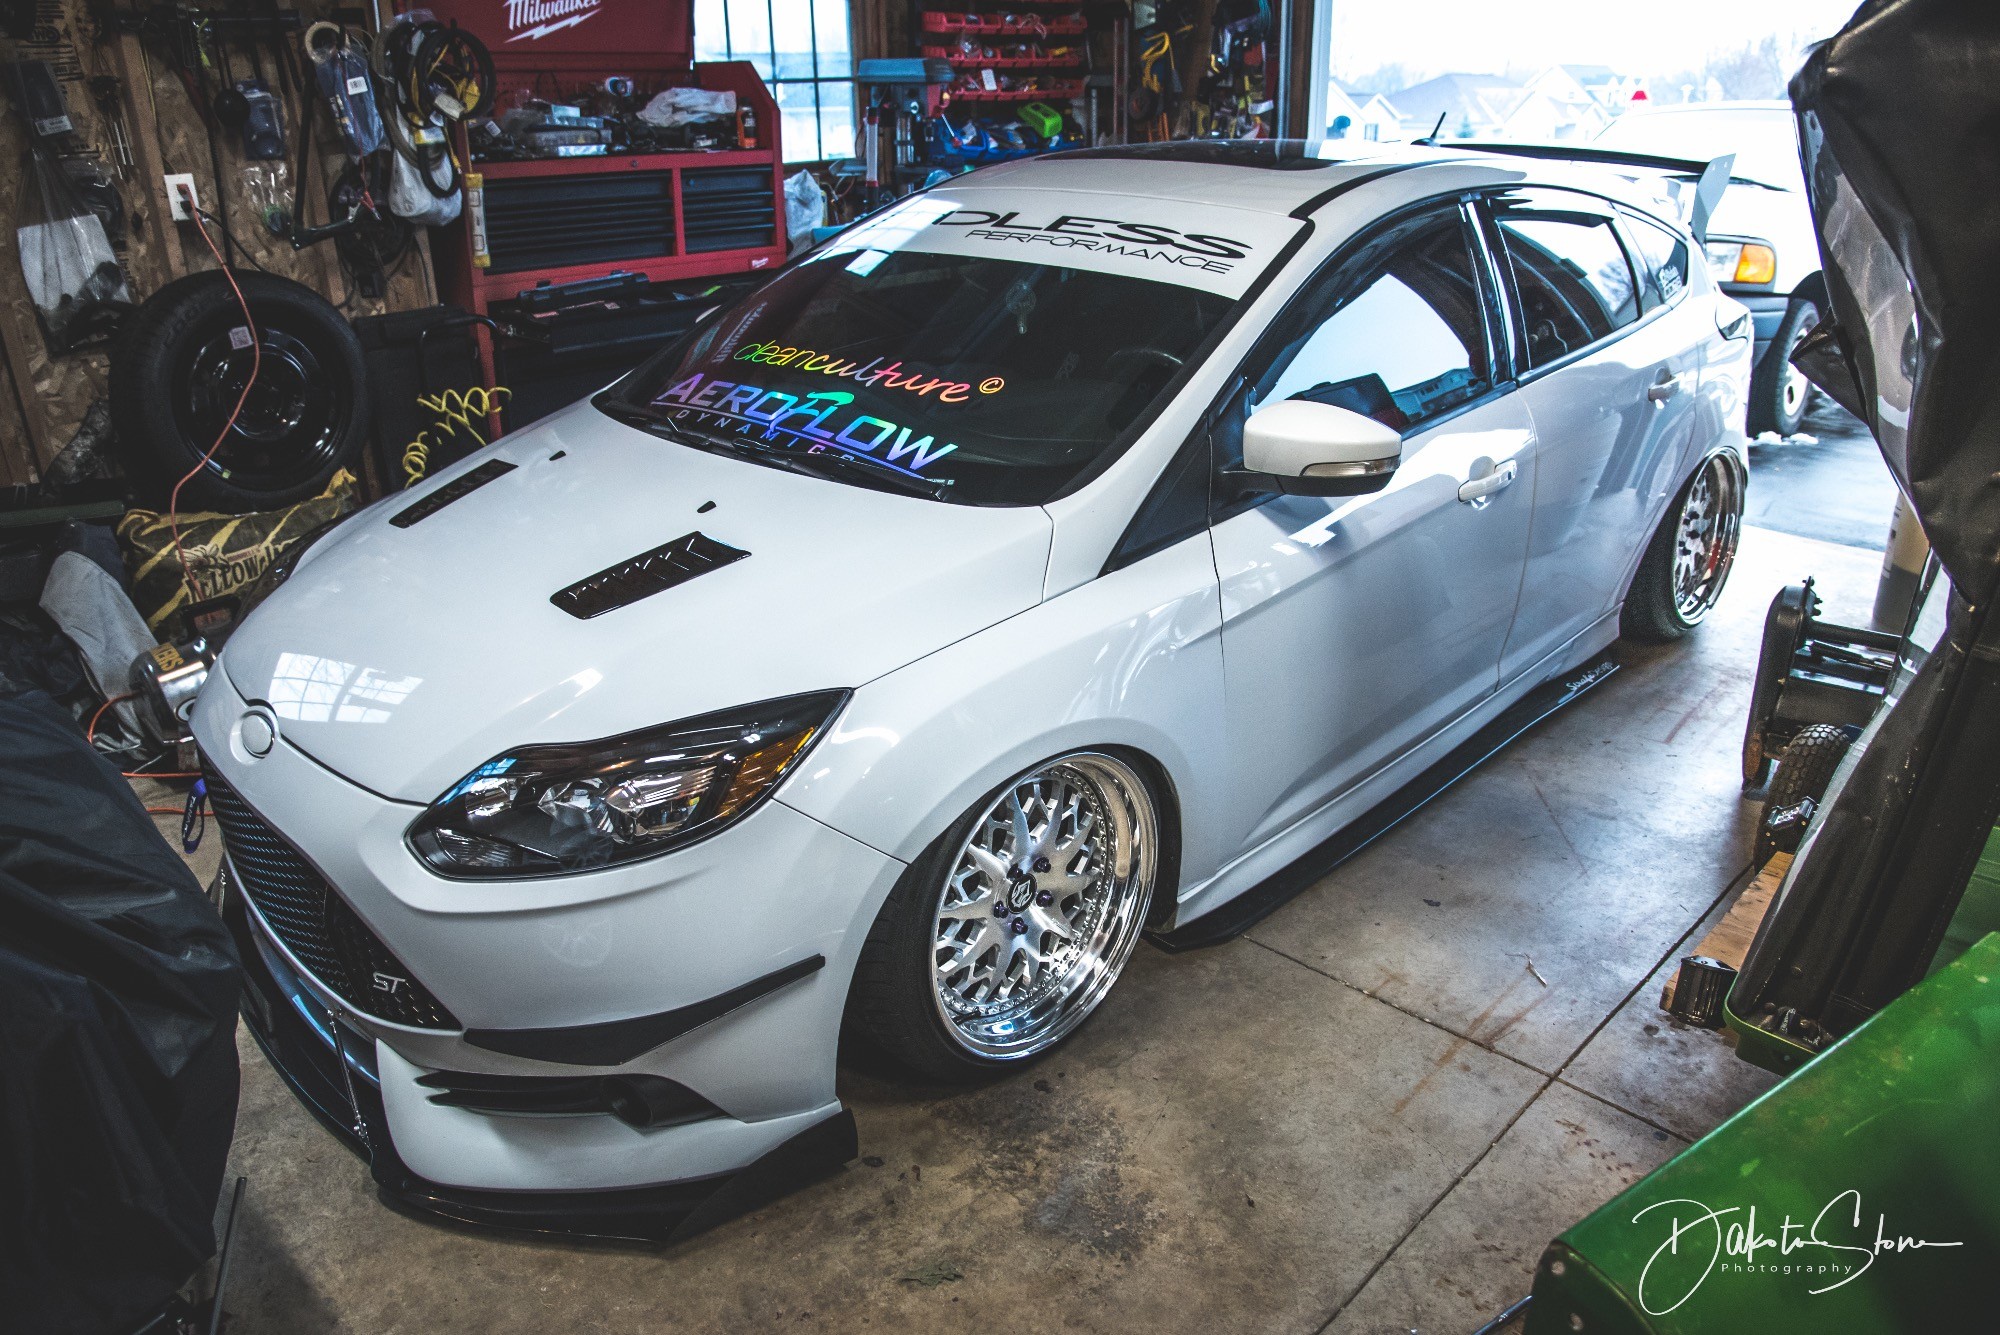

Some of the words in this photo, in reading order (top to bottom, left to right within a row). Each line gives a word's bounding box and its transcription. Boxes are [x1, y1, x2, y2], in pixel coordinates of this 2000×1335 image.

[932, 210, 1253, 259] DLESS
[964, 229, 1235, 275] PERFORMANCE
[733, 339, 971, 403] cleanculture
[656, 373, 959, 471] AEROFLOW
[372, 971, 406, 993] ST
